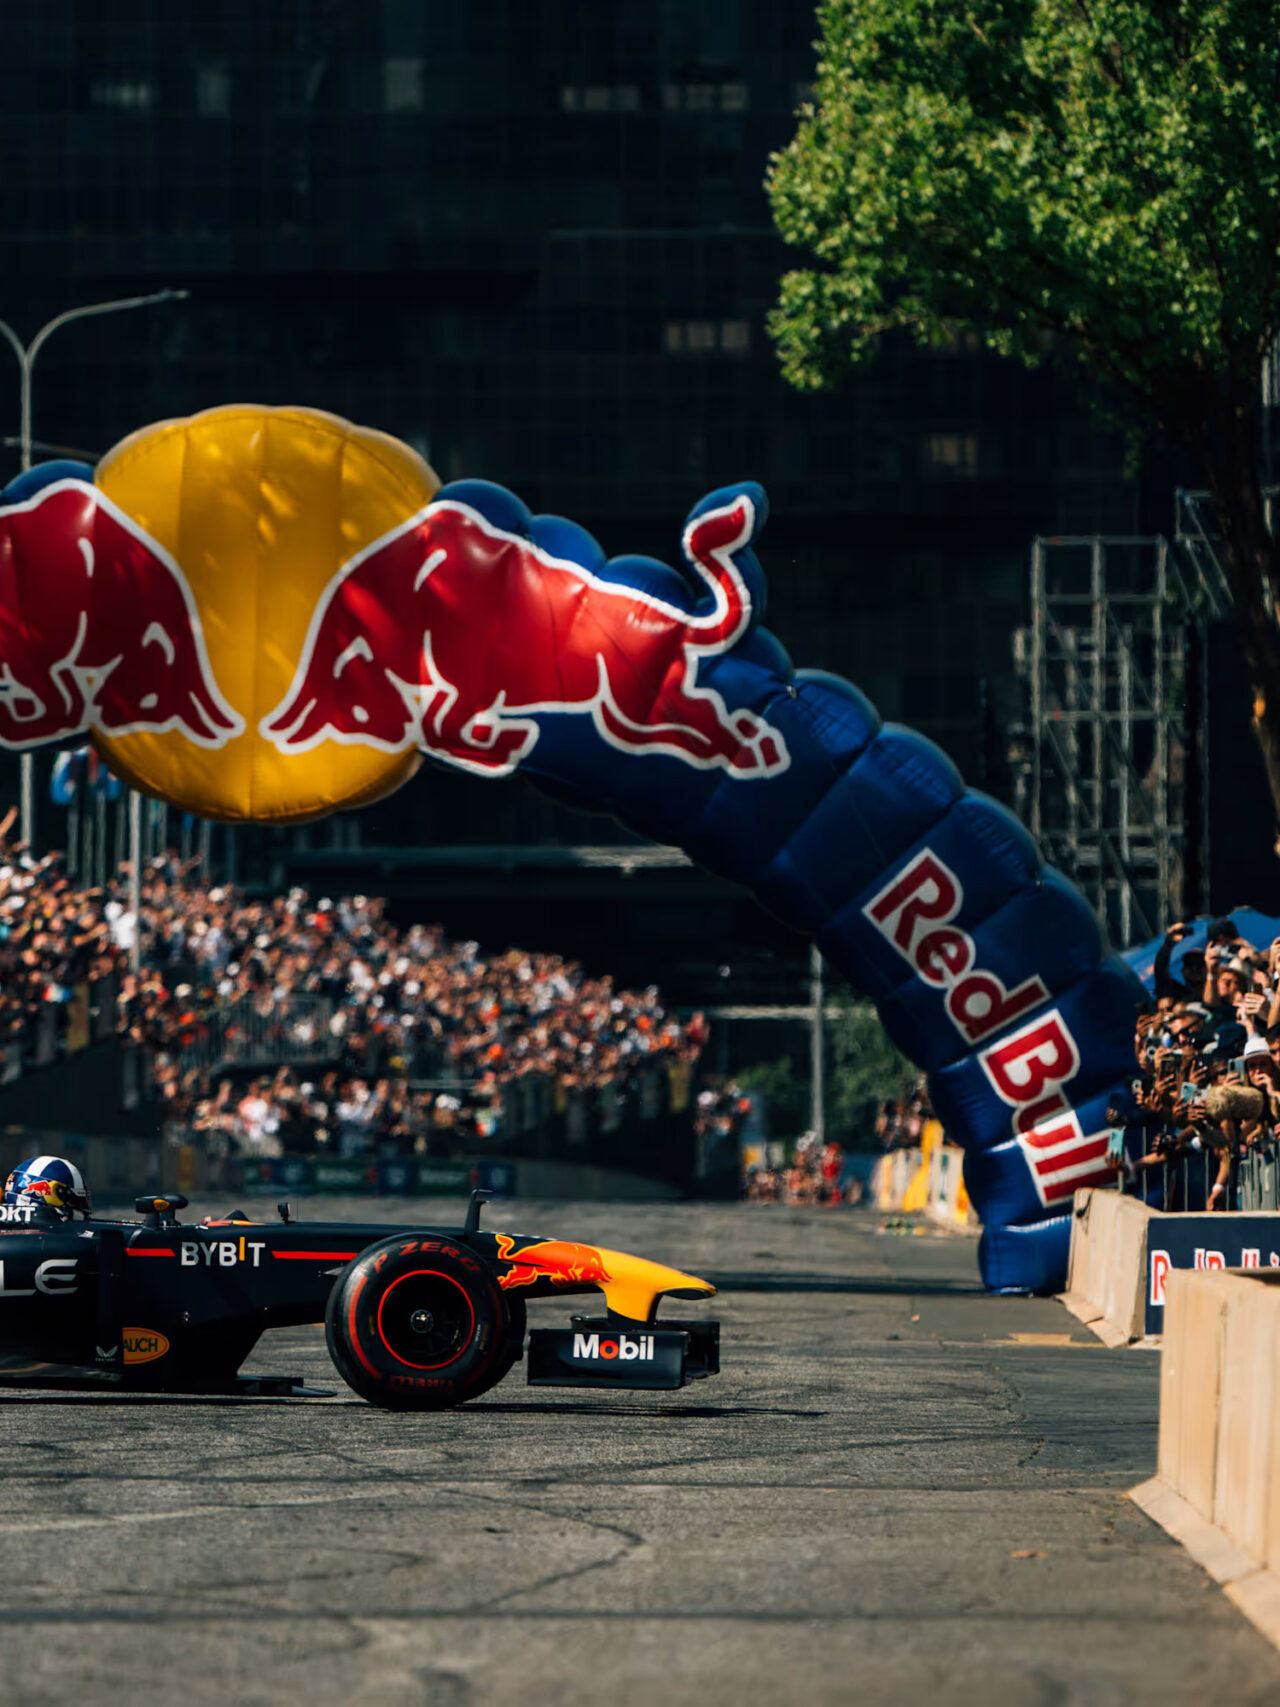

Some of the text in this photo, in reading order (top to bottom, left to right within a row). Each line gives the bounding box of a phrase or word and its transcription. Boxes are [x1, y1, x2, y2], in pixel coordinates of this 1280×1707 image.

[861, 846, 1136, 1208] Red Bull
[180, 1236, 266, 1268] BYBIT
[399, 1241, 481, 1272] ZERO
[123, 1337, 158, 1353] AUCH
[573, 1332, 655, 1361] Mobil
